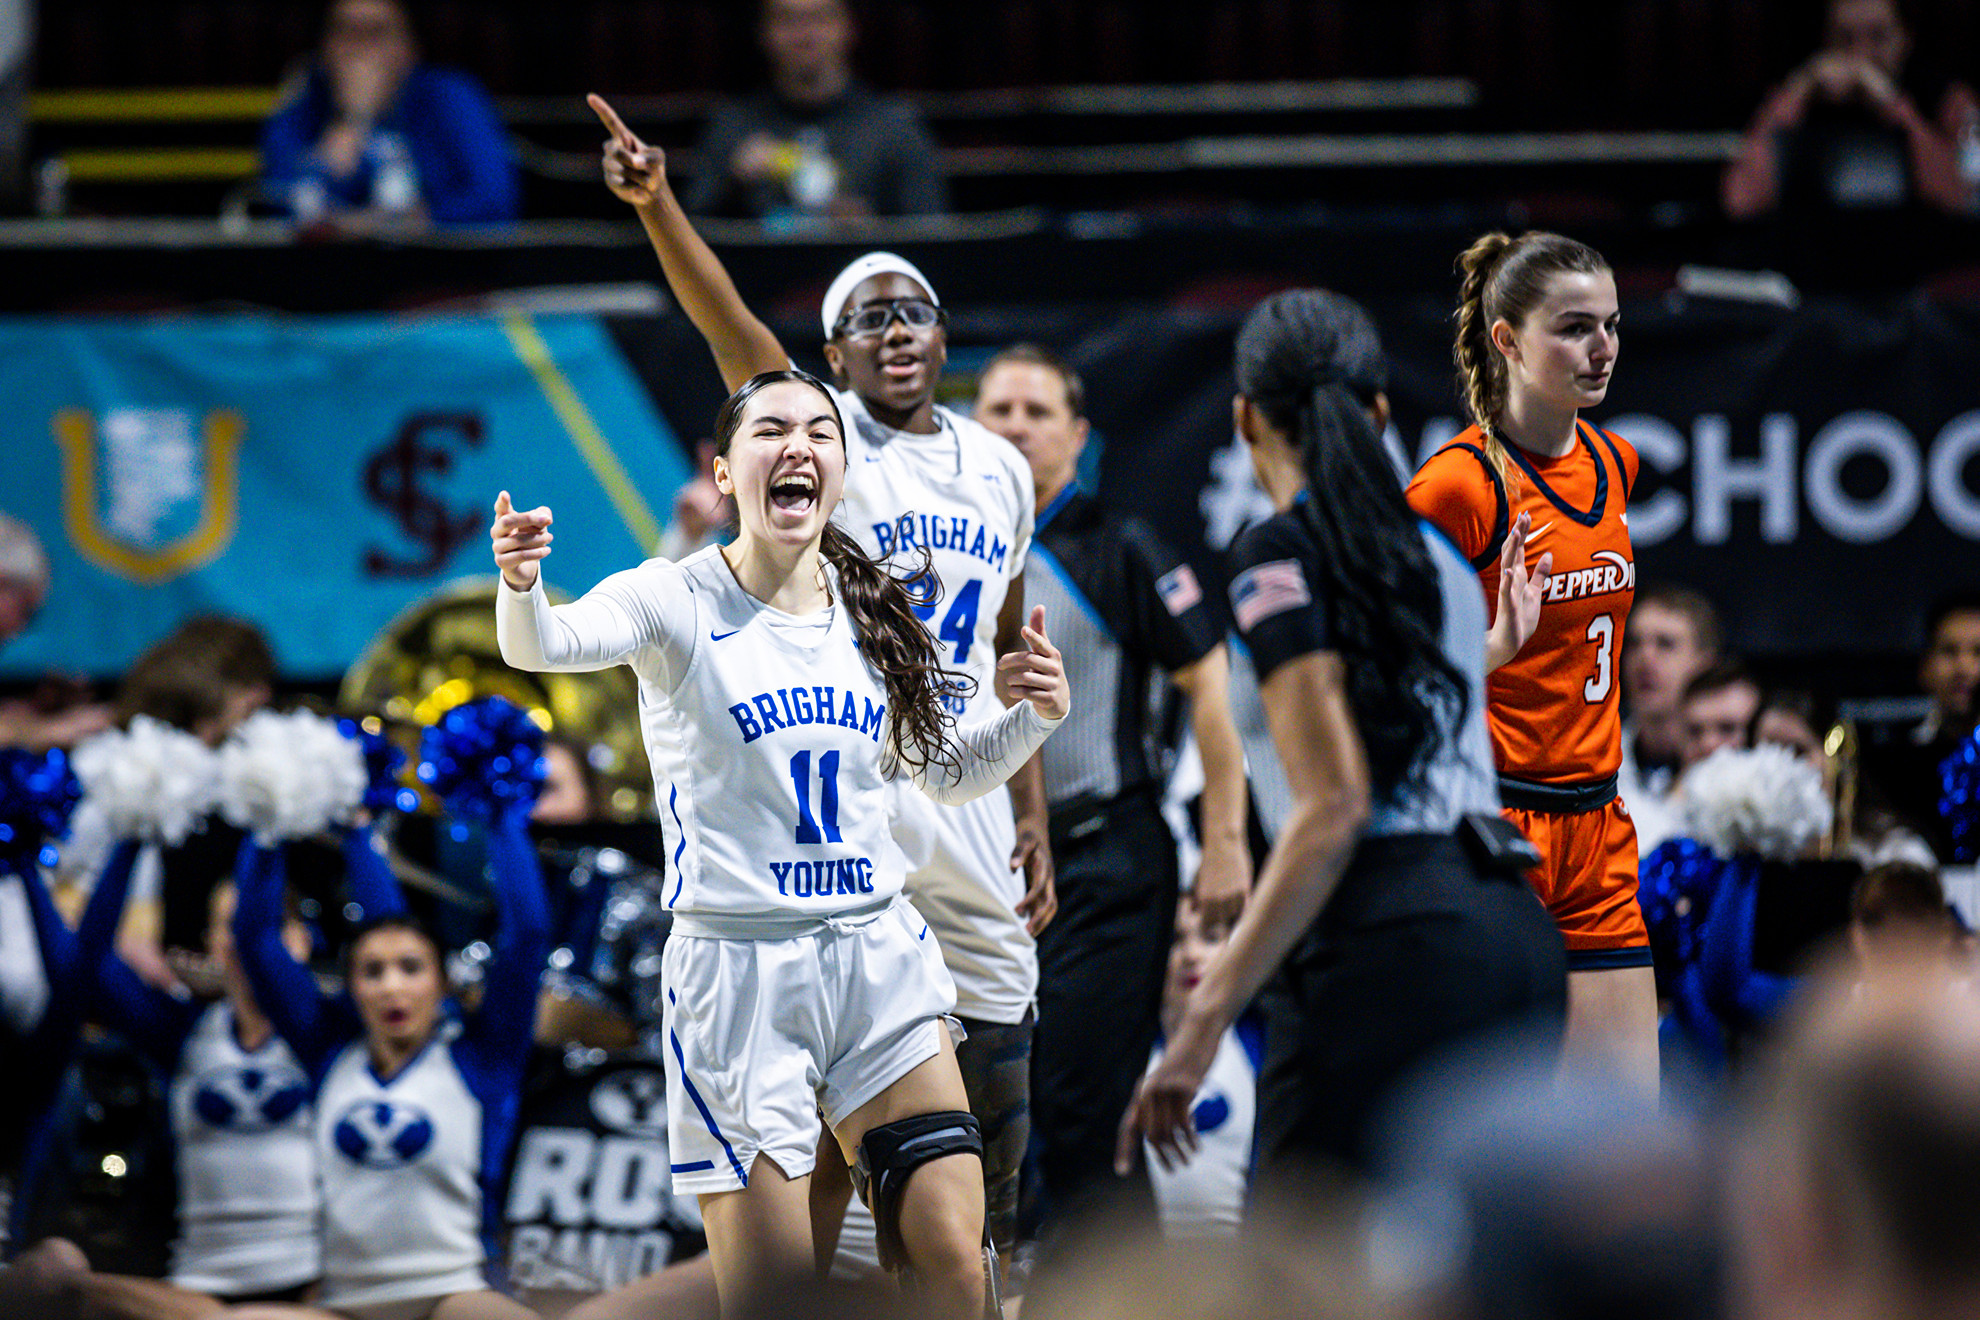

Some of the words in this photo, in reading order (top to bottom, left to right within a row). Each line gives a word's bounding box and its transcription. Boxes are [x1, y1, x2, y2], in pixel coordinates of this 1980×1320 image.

[873, 514, 1007, 573] BRIGHAM
[1583, 612, 1614, 705] 3
[728, 686, 886, 744] BRIGHAM
[790, 750, 843, 844] 11
[769, 858, 874, 897] YOUNG
[504, 1126, 705, 1231] RO
